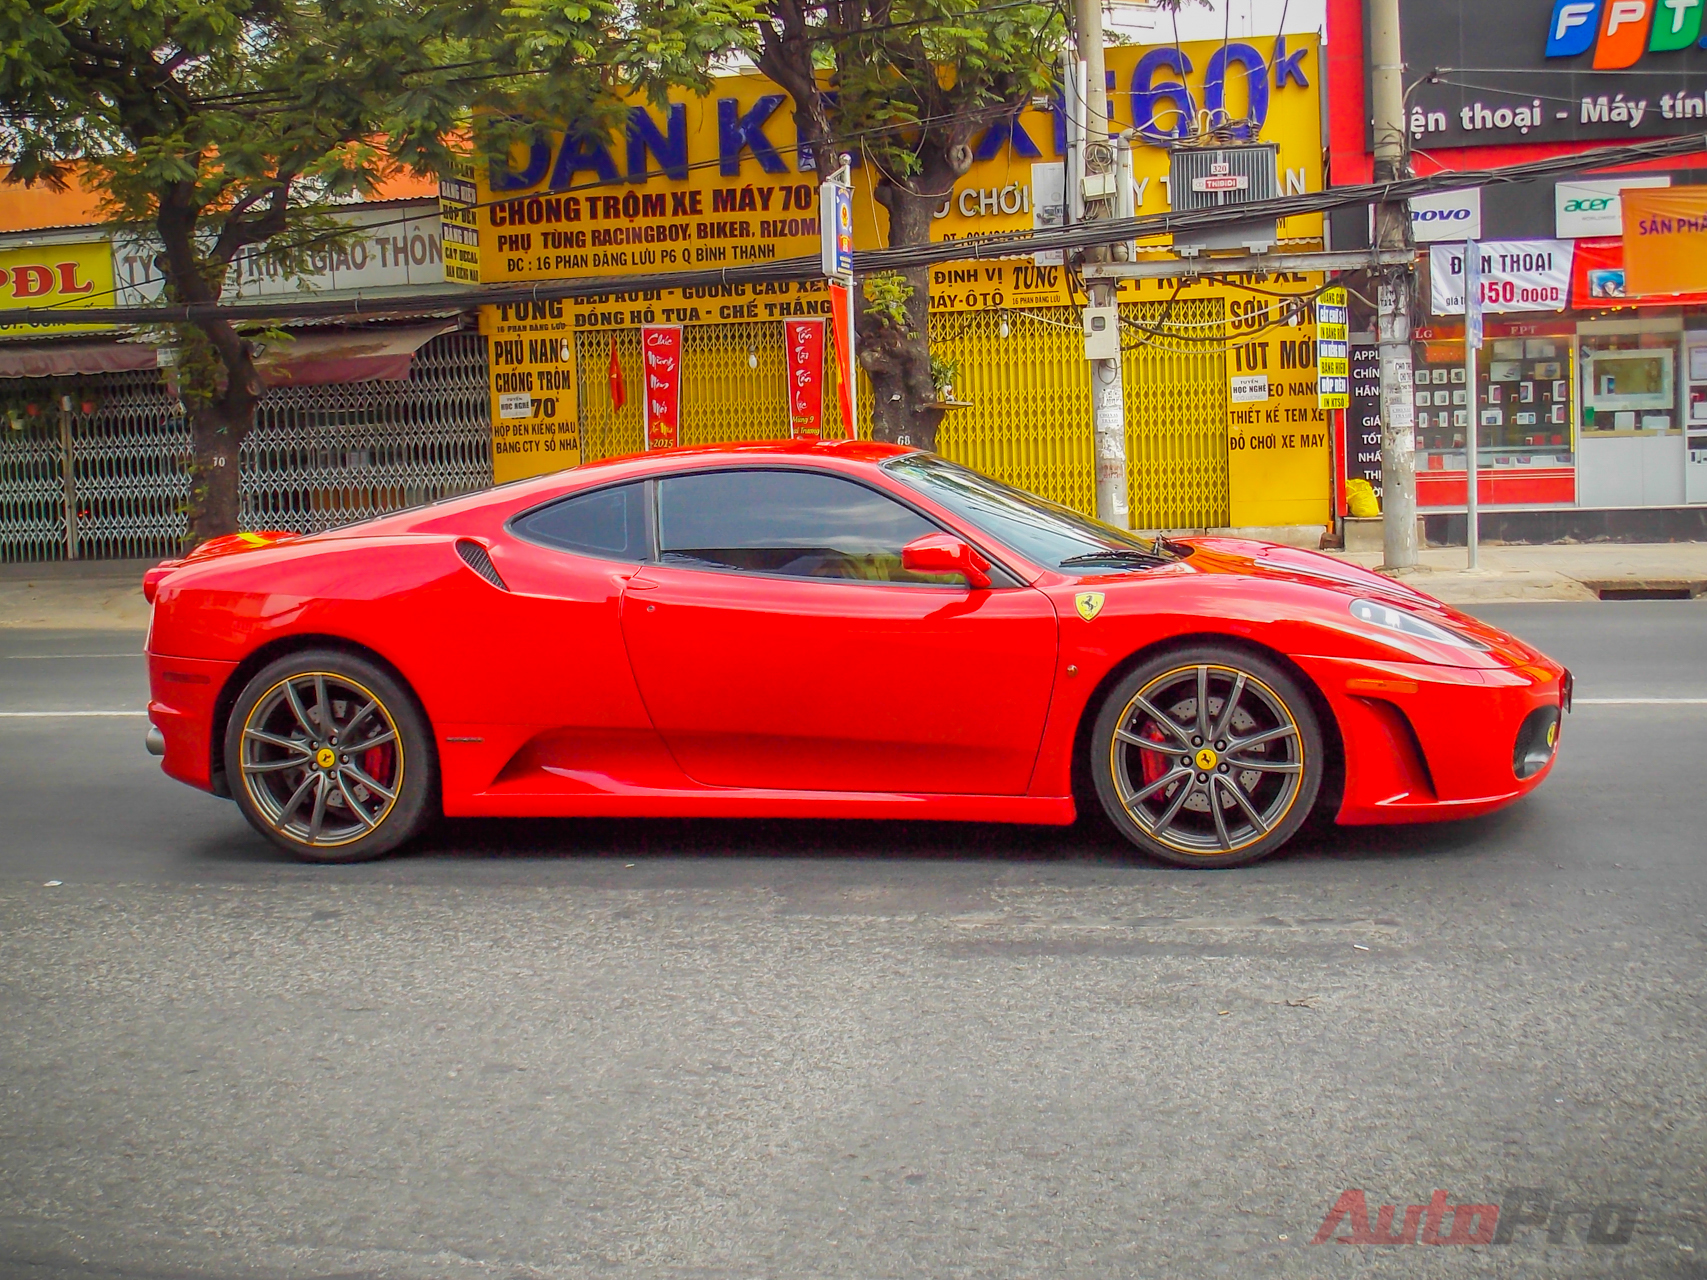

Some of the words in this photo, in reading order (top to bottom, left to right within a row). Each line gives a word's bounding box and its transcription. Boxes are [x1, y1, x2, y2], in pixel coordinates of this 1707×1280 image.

[1461, 100, 1541, 134] thoại
[1581, 93, 1646, 128] Máy
[1660, 88, 1707, 120] tín
[1213, 165, 1227, 173] 320
[585, 190, 666, 223] TRỘM
[671, 190, 703, 217] XE
[713, 184, 774, 213] MÁY
[959, 181, 1029, 217] CHƠI
[1563, 197, 1615, 213] acer
[1639, 213, 1672, 235] SẢN
[376, 226, 442, 268] THÔN
[498, 233, 531, 254] PHỤ
[541, 229, 586, 250] TÙNG
[536, 256, 551, 271] 16
[556, 253, 588, 269] PHAN
[593, 250, 627, 267] ĐĂNG
[661, 249, 677, 264] P6
[682, 248, 691, 265] Q
[696, 244, 726, 263] BÌNH
[731, 243, 775, 263] THẠNH
[1499, 252, 1552, 275] THOẠI
[934, 268, 978, 288] ĐỊNH
[985, 267, 1003, 285] VỊ
[1012, 261, 1058, 291] TÙNG
[574, 307, 624, 327] ĐỒNG
[630, 304, 655, 324] HỒ
[662, 307, 701, 322] TUA
[719, 298, 758, 319] CHẾ
[764, 296, 832, 317] THẮNG
[1230, 296, 1269, 330] SƠN
[1414, 329, 1433, 339] LG
[1510, 325, 1538, 335] FPT
[494, 334, 524, 365] PHỦ
[1353, 350, 1380, 361] APPL
[495, 366, 533, 393] CHỐNG
[1353, 365, 1380, 379] CHÍN
[1355, 384, 1380, 396] HÃN
[1230, 404, 1261, 424] THIẾT
[1266, 402, 1280, 423] KẾ
[1284, 408, 1307, 422] TEM
[1311, 408, 1325, 422] XE
[1362, 413, 1381, 427] GIÁ
[513, 421, 529, 436] ĐÈN
[560, 436, 578, 452] NHÀ
[653, 438, 674, 449] 2015
[1230, 429, 1246, 450] ĐỒ
[1250, 433, 1276, 450] CHƠI
[1282, 434, 1296, 448] XE
[1358, 448, 1382, 463] NHẤ
